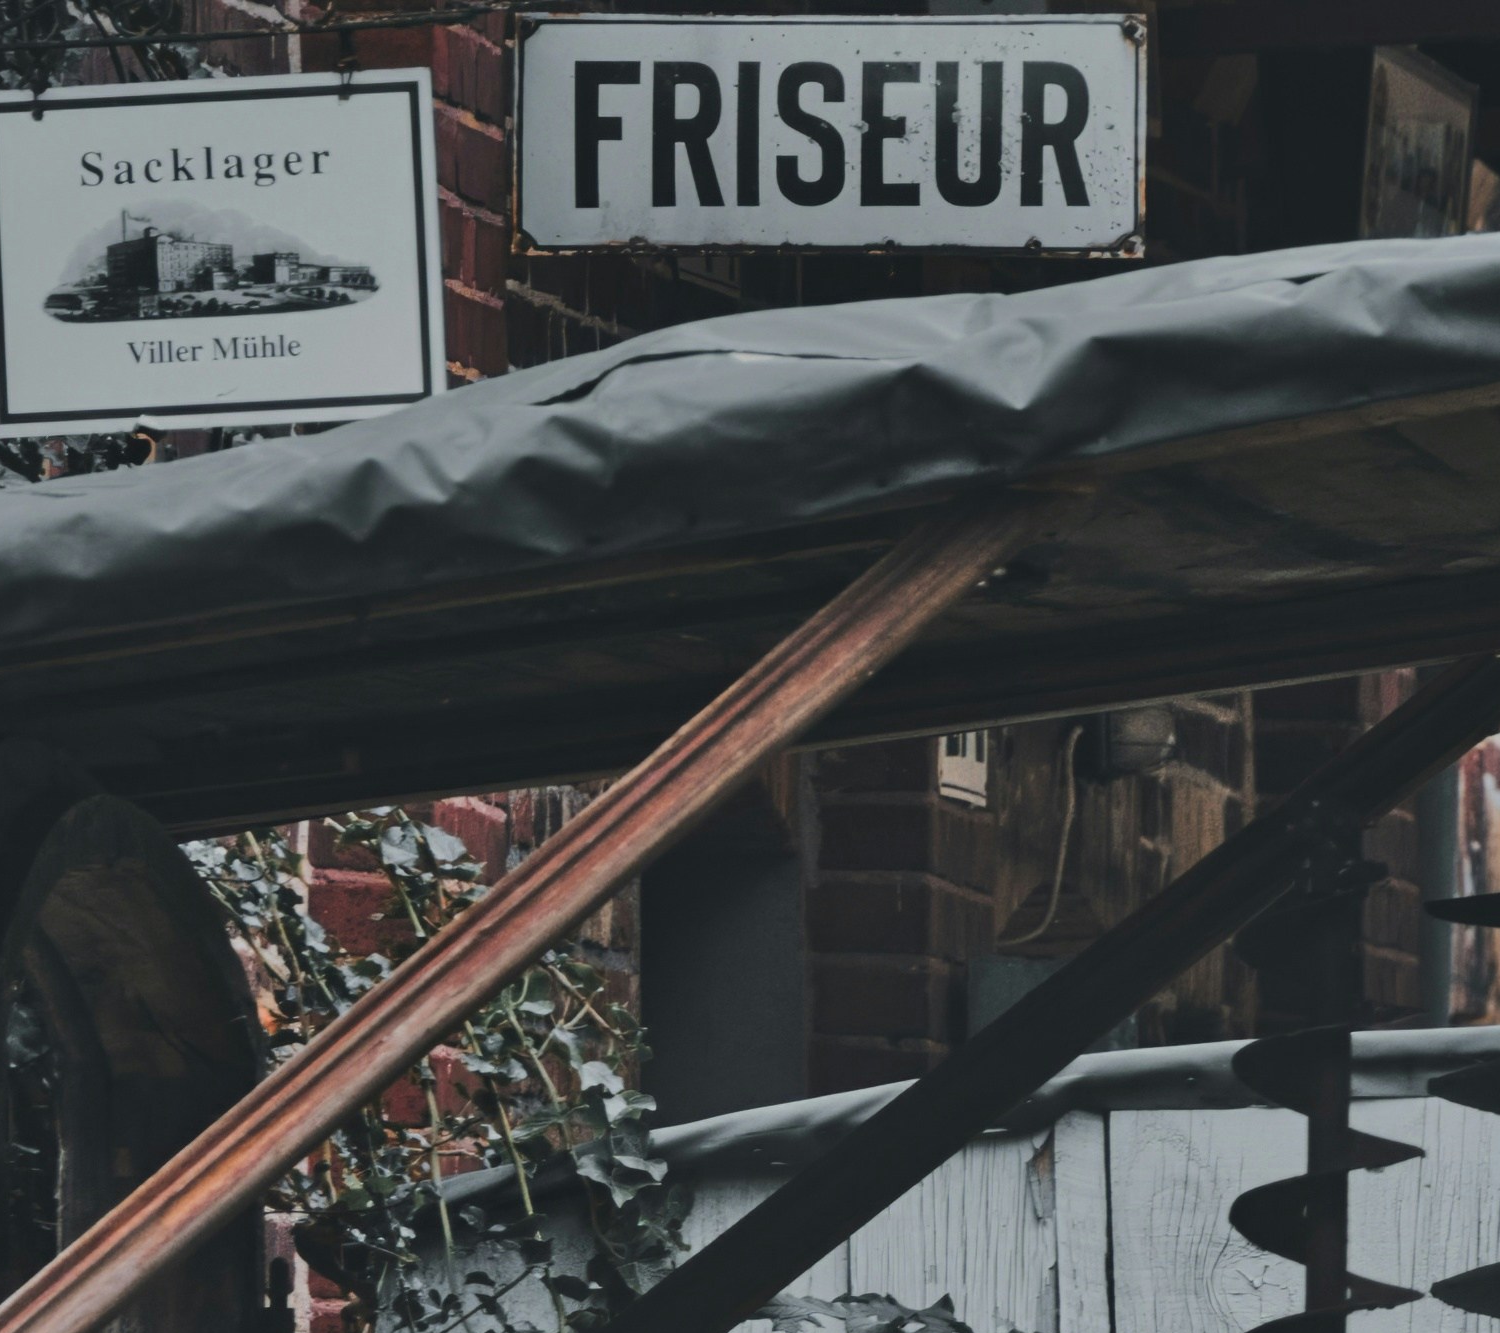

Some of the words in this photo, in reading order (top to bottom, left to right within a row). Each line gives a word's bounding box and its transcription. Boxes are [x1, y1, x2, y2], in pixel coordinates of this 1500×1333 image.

[574, 60, 1091, 208] FRISEUR
[79, 145, 331, 191] Sacklager
[127, 339, 203, 365] Viller
[212, 334, 302, 362] Mühle
